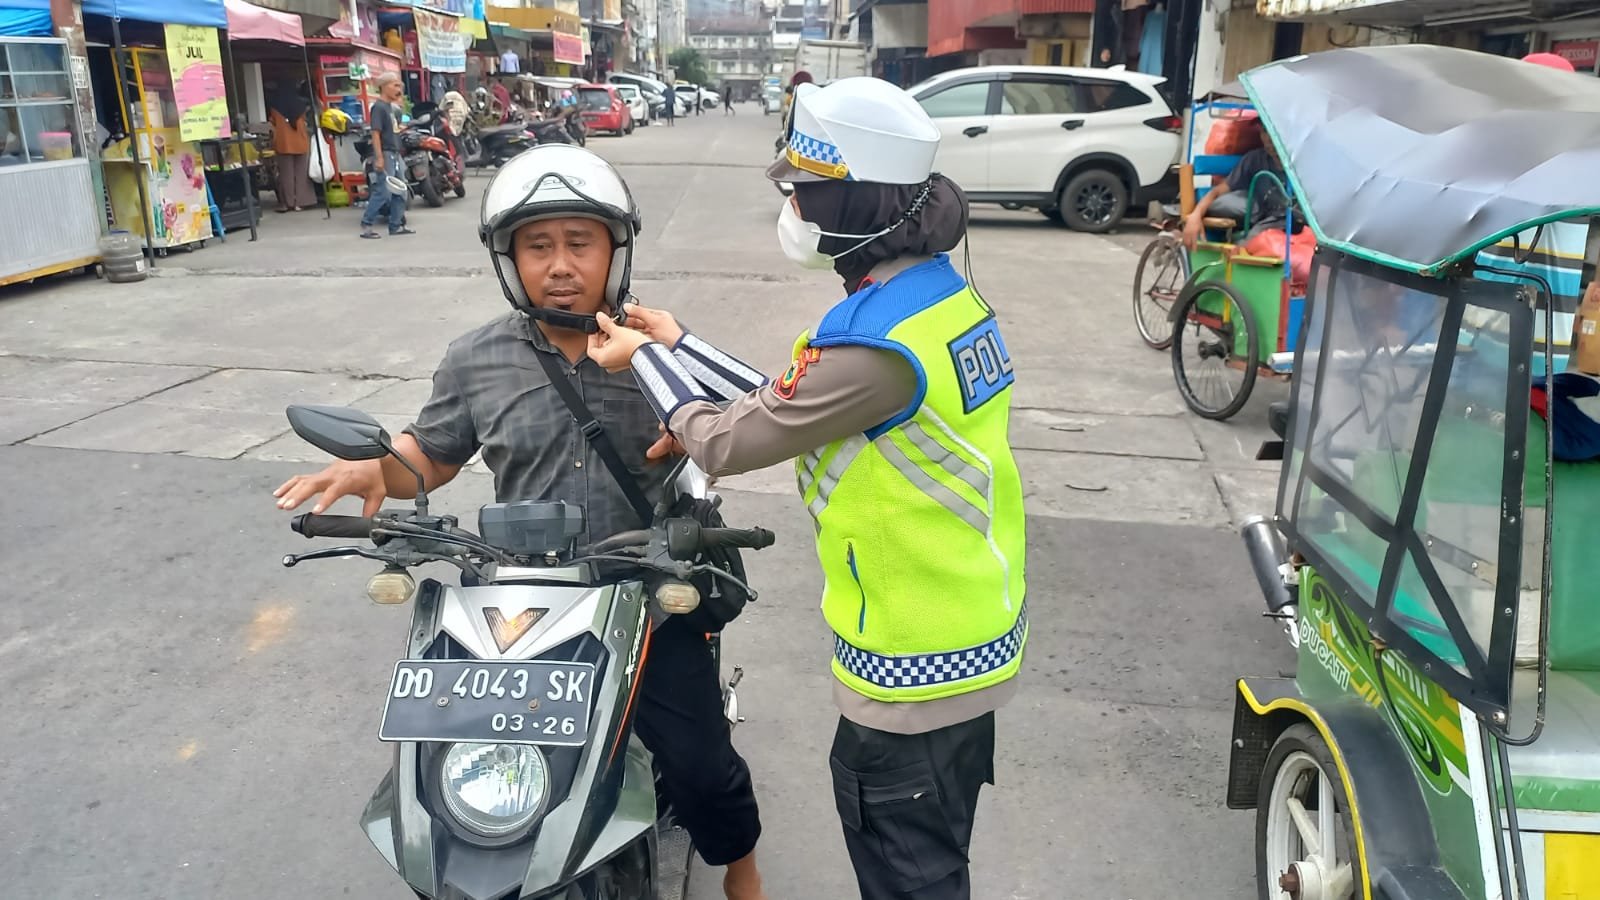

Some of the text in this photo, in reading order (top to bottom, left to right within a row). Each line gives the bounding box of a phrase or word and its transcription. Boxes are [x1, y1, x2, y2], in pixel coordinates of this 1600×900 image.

[1299, 615, 1351, 692] DUCATI
[393, 667, 587, 703] DD 4043 SK
